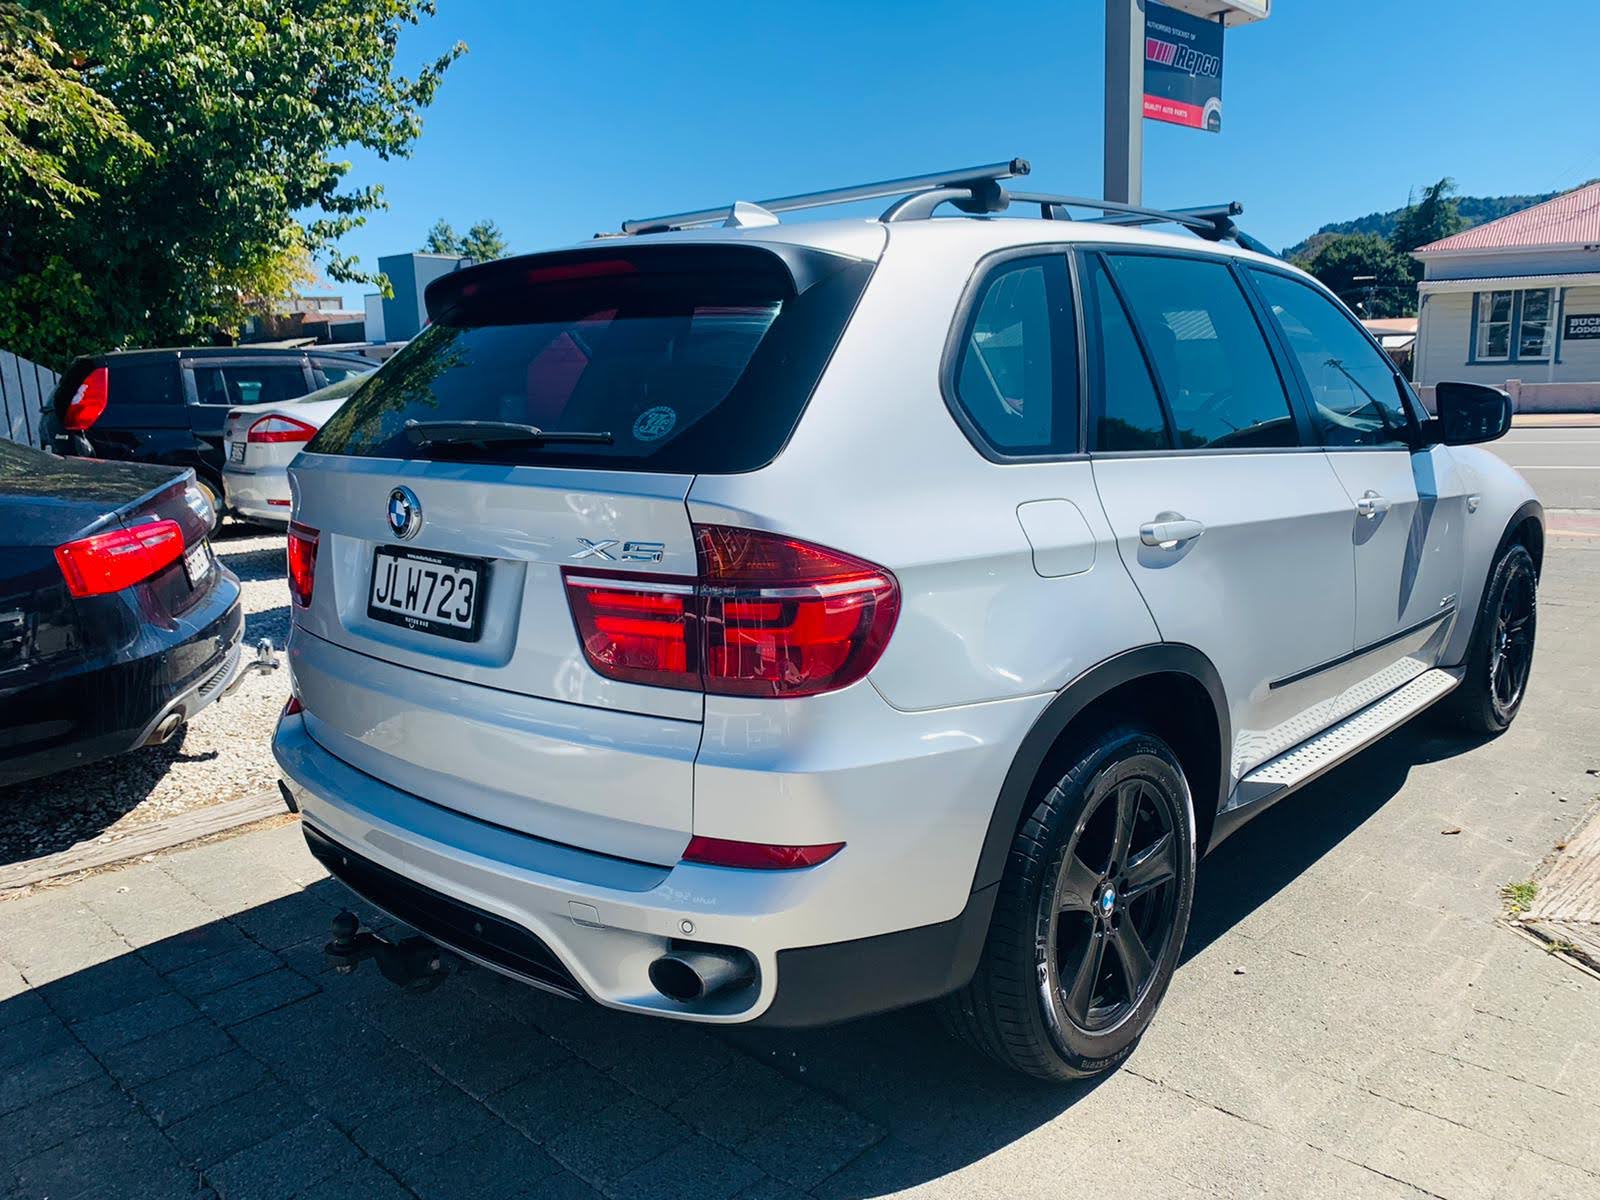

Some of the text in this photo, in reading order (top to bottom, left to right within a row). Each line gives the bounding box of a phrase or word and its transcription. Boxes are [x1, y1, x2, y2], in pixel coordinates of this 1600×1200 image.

[1174, 44, 1219, 77] Repco
[1144, 101, 1188, 118] QUALITY AUTO PARTS
[568, 537, 665, 564] X5
[376, 563, 474, 623] JLW723
